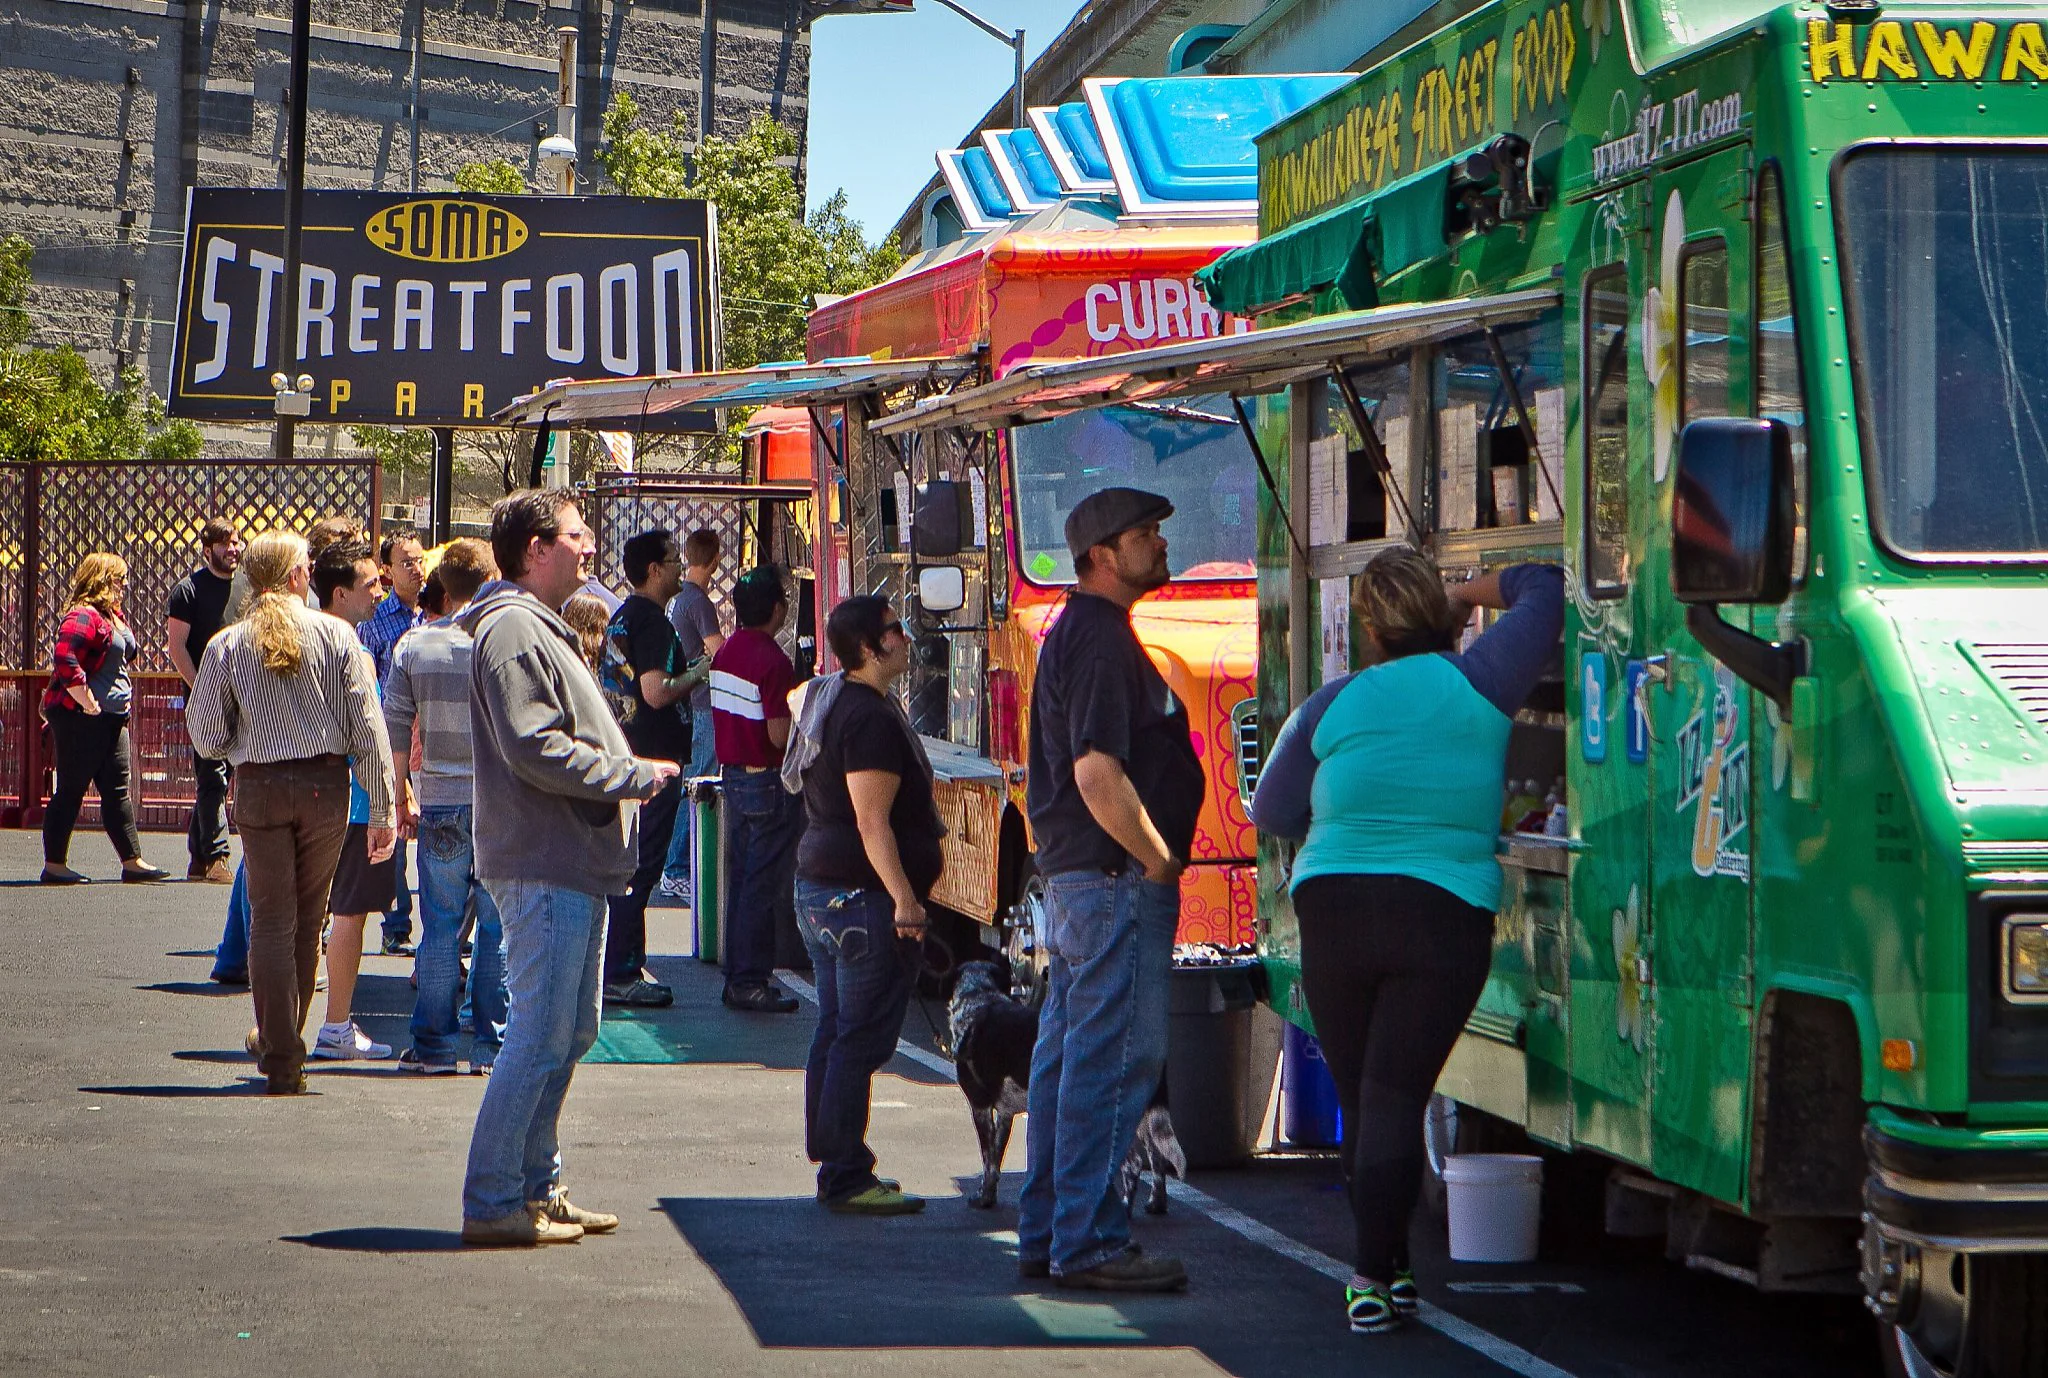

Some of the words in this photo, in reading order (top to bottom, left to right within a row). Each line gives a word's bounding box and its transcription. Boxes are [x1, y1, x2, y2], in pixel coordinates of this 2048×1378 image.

[1267, 91, 1403, 236] HAWAIIANESE
[1411, 38, 1498, 172] STREET
[1511, 2, 1577, 123] FOOD
[384, 203, 510, 260] SOMA
[194, 236, 693, 384] STREATFOOD
[1085, 277, 1247, 342] CURR
[330, 379, 540, 418] PAR
